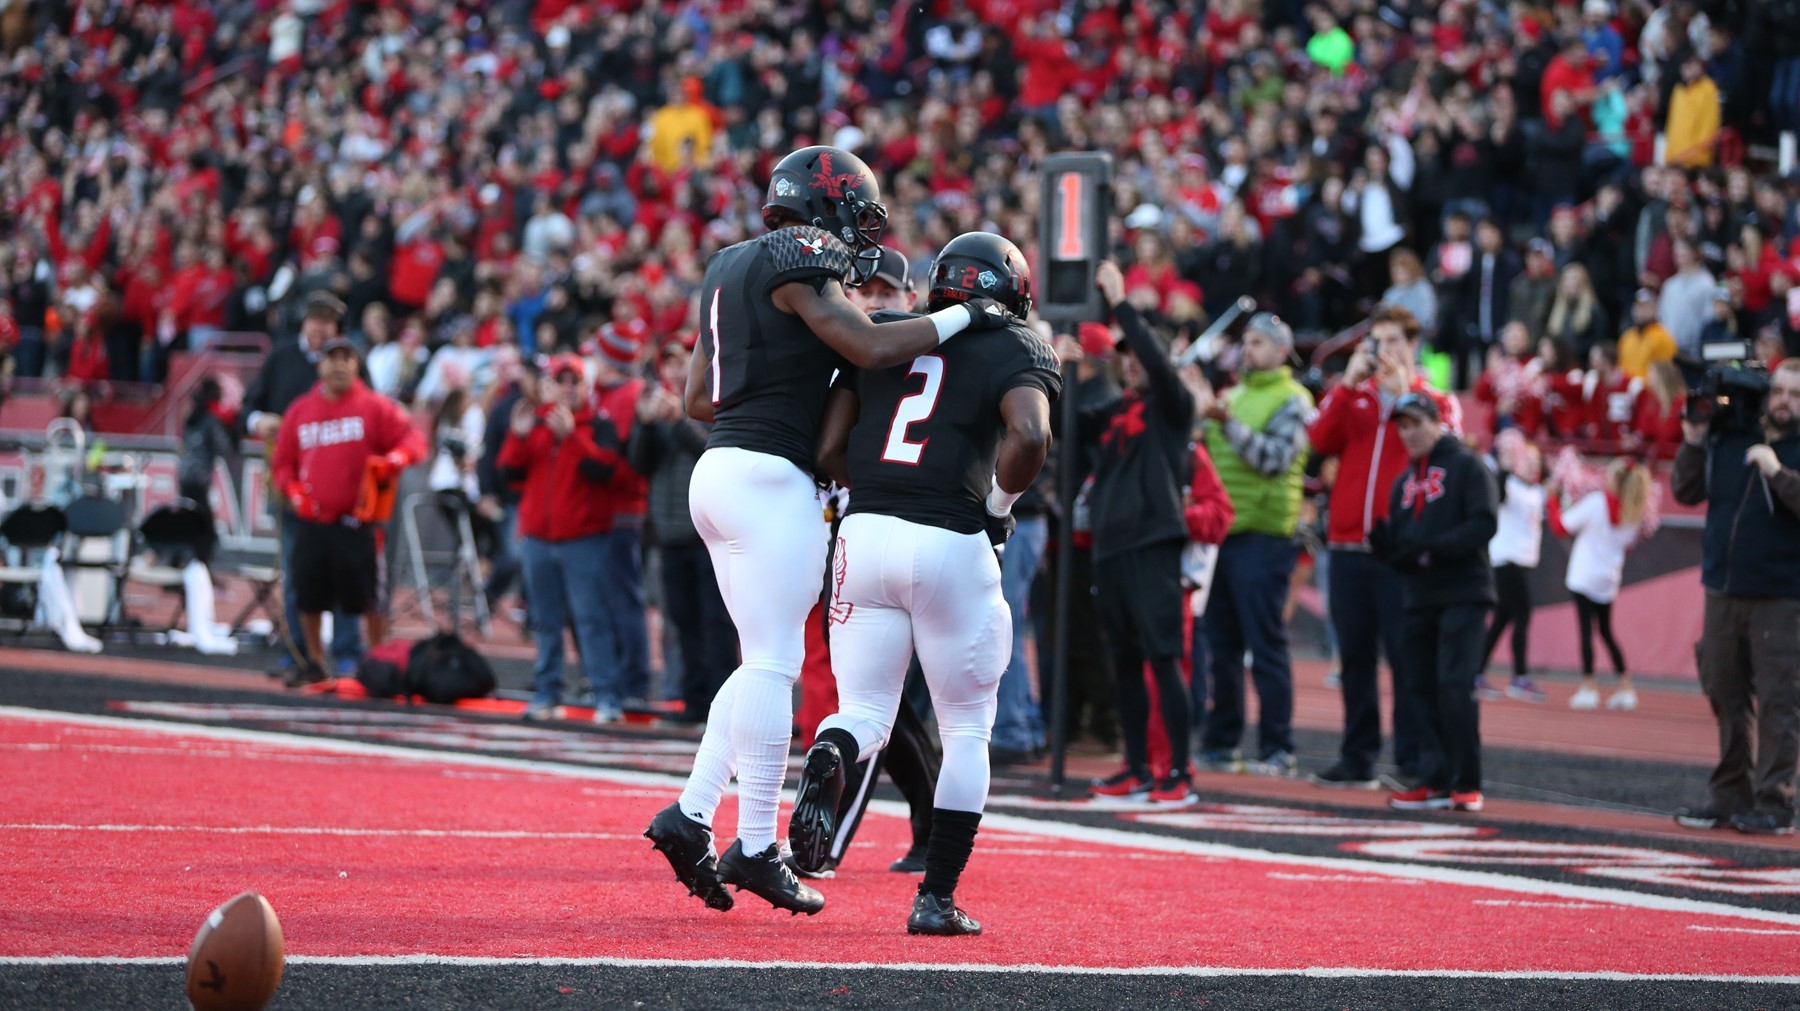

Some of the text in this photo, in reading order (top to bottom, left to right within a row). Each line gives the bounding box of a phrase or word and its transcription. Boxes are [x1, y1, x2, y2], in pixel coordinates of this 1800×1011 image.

[1058, 171, 1083, 261] 1
[943, 288, 969, 301] EAGLES
[961, 266, 979, 289] 2
[709, 286, 721, 406] 1
[880, 352, 947, 466] 2
